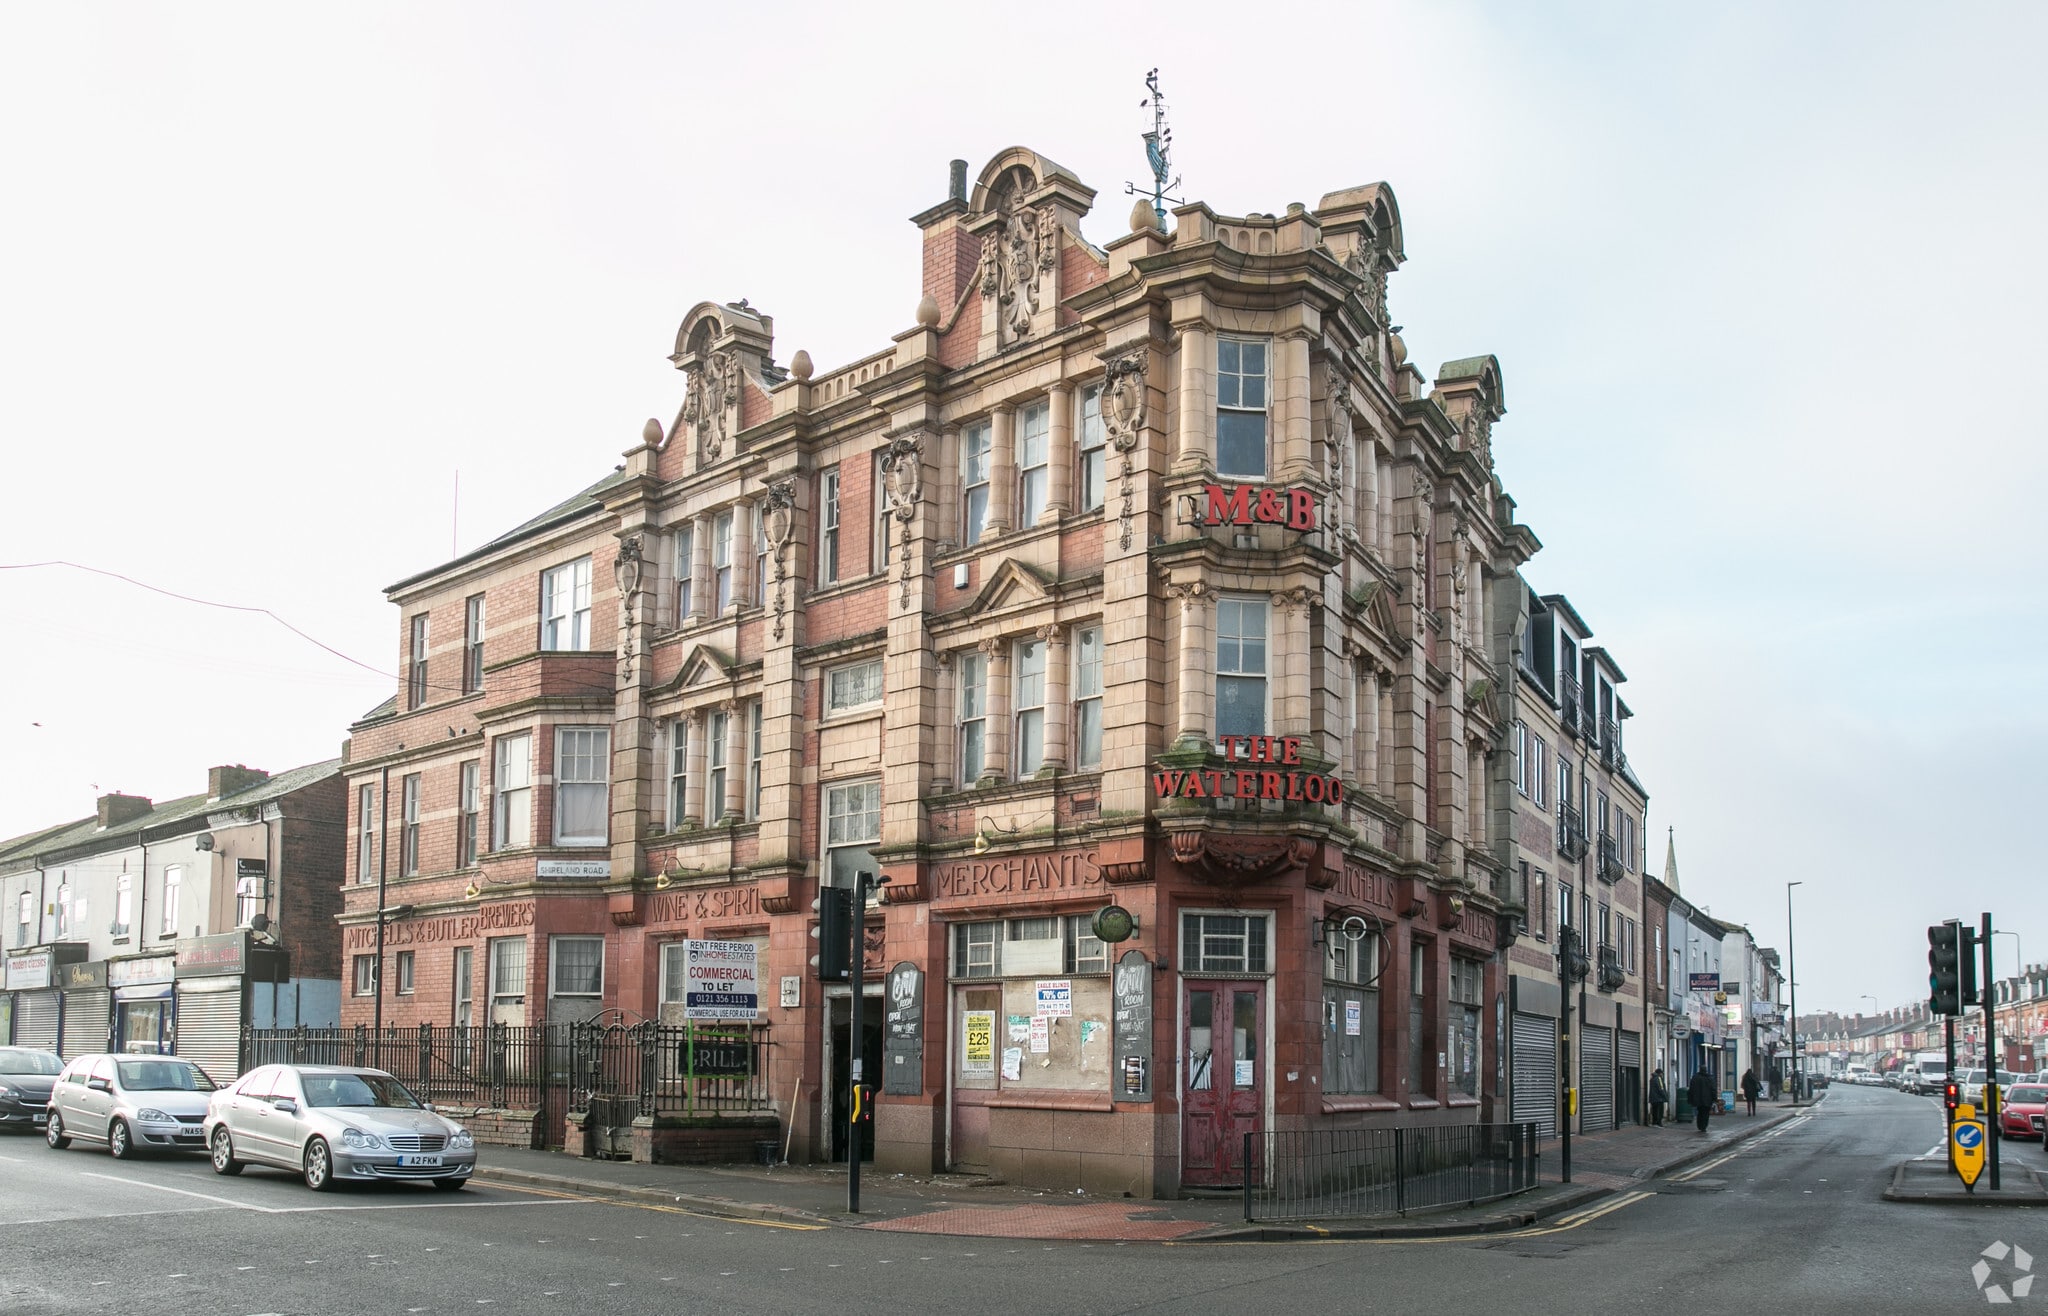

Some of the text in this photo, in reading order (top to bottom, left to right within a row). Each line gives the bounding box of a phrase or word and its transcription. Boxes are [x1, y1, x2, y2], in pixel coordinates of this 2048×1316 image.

[1204, 485, 1316, 531] M&B
[1220, 735, 1301, 765] THE
[1153, 770, 1344, 805] WATERLOO
[936, 852, 1102, 899] MERCHANTS
[1330, 863, 1394, 910] ITCHELLS
[652, 893, 689, 922] WINE
[695, 890, 709, 919] &
[415, 920, 427, 943] &
[480, 902, 536, 930] BREWERS
[690, 941, 754, 952] RENT FREE PERIOD
[690, 967, 755, 980] COMMERCIAL
[702, 982, 734, 991] TO LET
[696, 994, 749, 1004] 0121 356 1113
[1042, 990, 1069, 1000] 70% OFF
[689, 1009, 719, 1017] COMMERCIAL
[720, 1009, 729, 1017] USE
[968, 1032, 989, 1046] £25
[410, 1156, 421, 1165] A2
